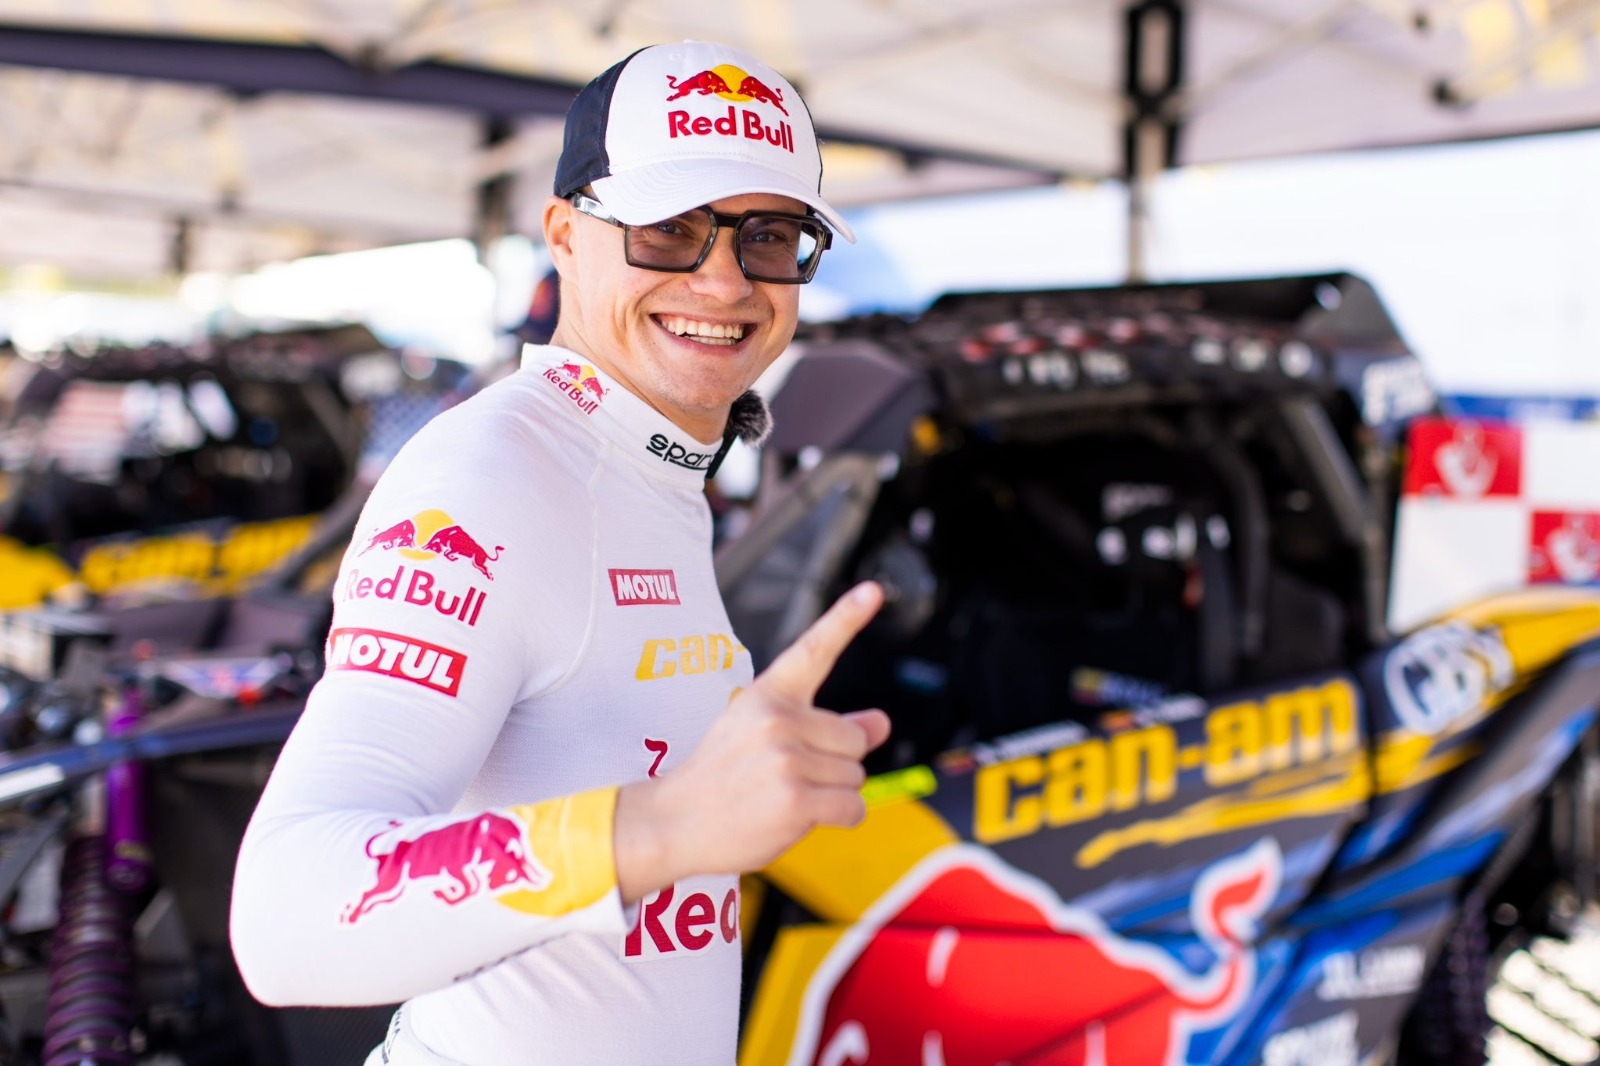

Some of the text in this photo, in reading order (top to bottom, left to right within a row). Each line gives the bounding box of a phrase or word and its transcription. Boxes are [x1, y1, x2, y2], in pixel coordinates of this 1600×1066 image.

[668, 105, 794, 153] Red Bull
[543, 368, 599, 416] Red Bull
[647, 433, 716, 470] spar
[343, 565, 487, 627] Red Bull
[616, 574, 676, 601] MOTUL
[330, 633, 454, 689] MOTUL
[973, 678, 1359, 844] can-am
